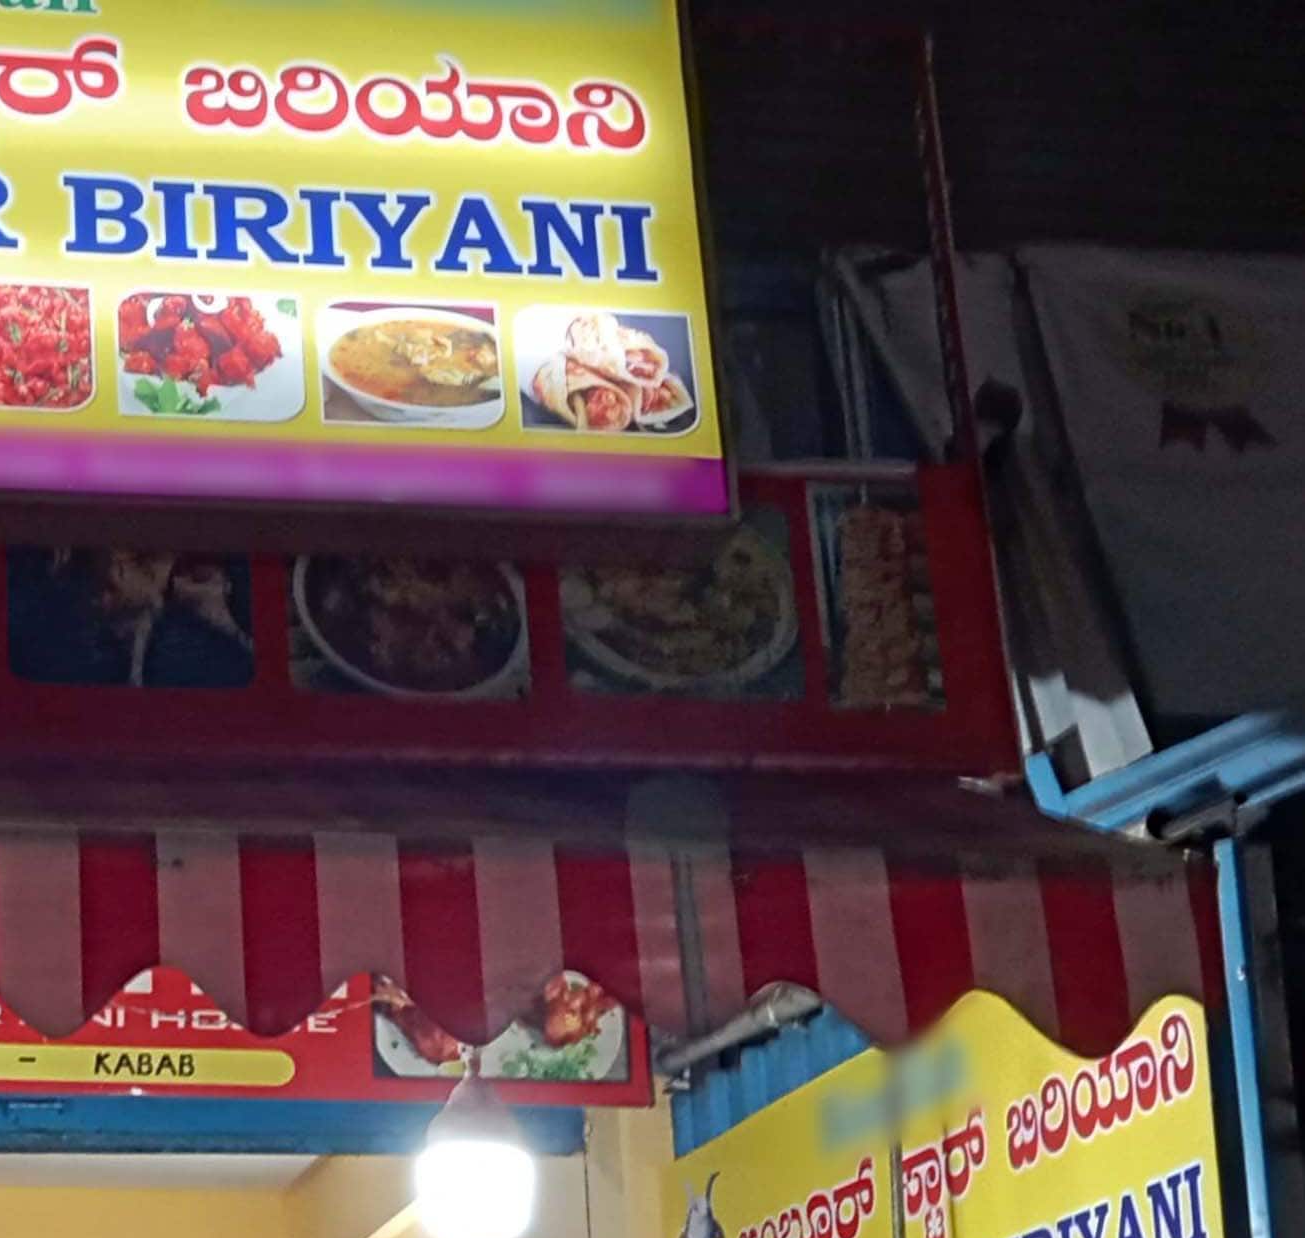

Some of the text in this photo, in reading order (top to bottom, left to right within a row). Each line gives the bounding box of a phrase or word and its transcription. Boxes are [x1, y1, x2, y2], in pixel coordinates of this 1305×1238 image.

[185, 55, 647, 149] ಬಿರಿಯಾನಿ
[64, 175, 659, 282] BIRIYANI
[94, 1053, 195, 1077] KABAB
[150, 1008, 339, 1033] HOE
[1007, 1015, 1194, 1168] ಬಿರಿಯಾನಿ
